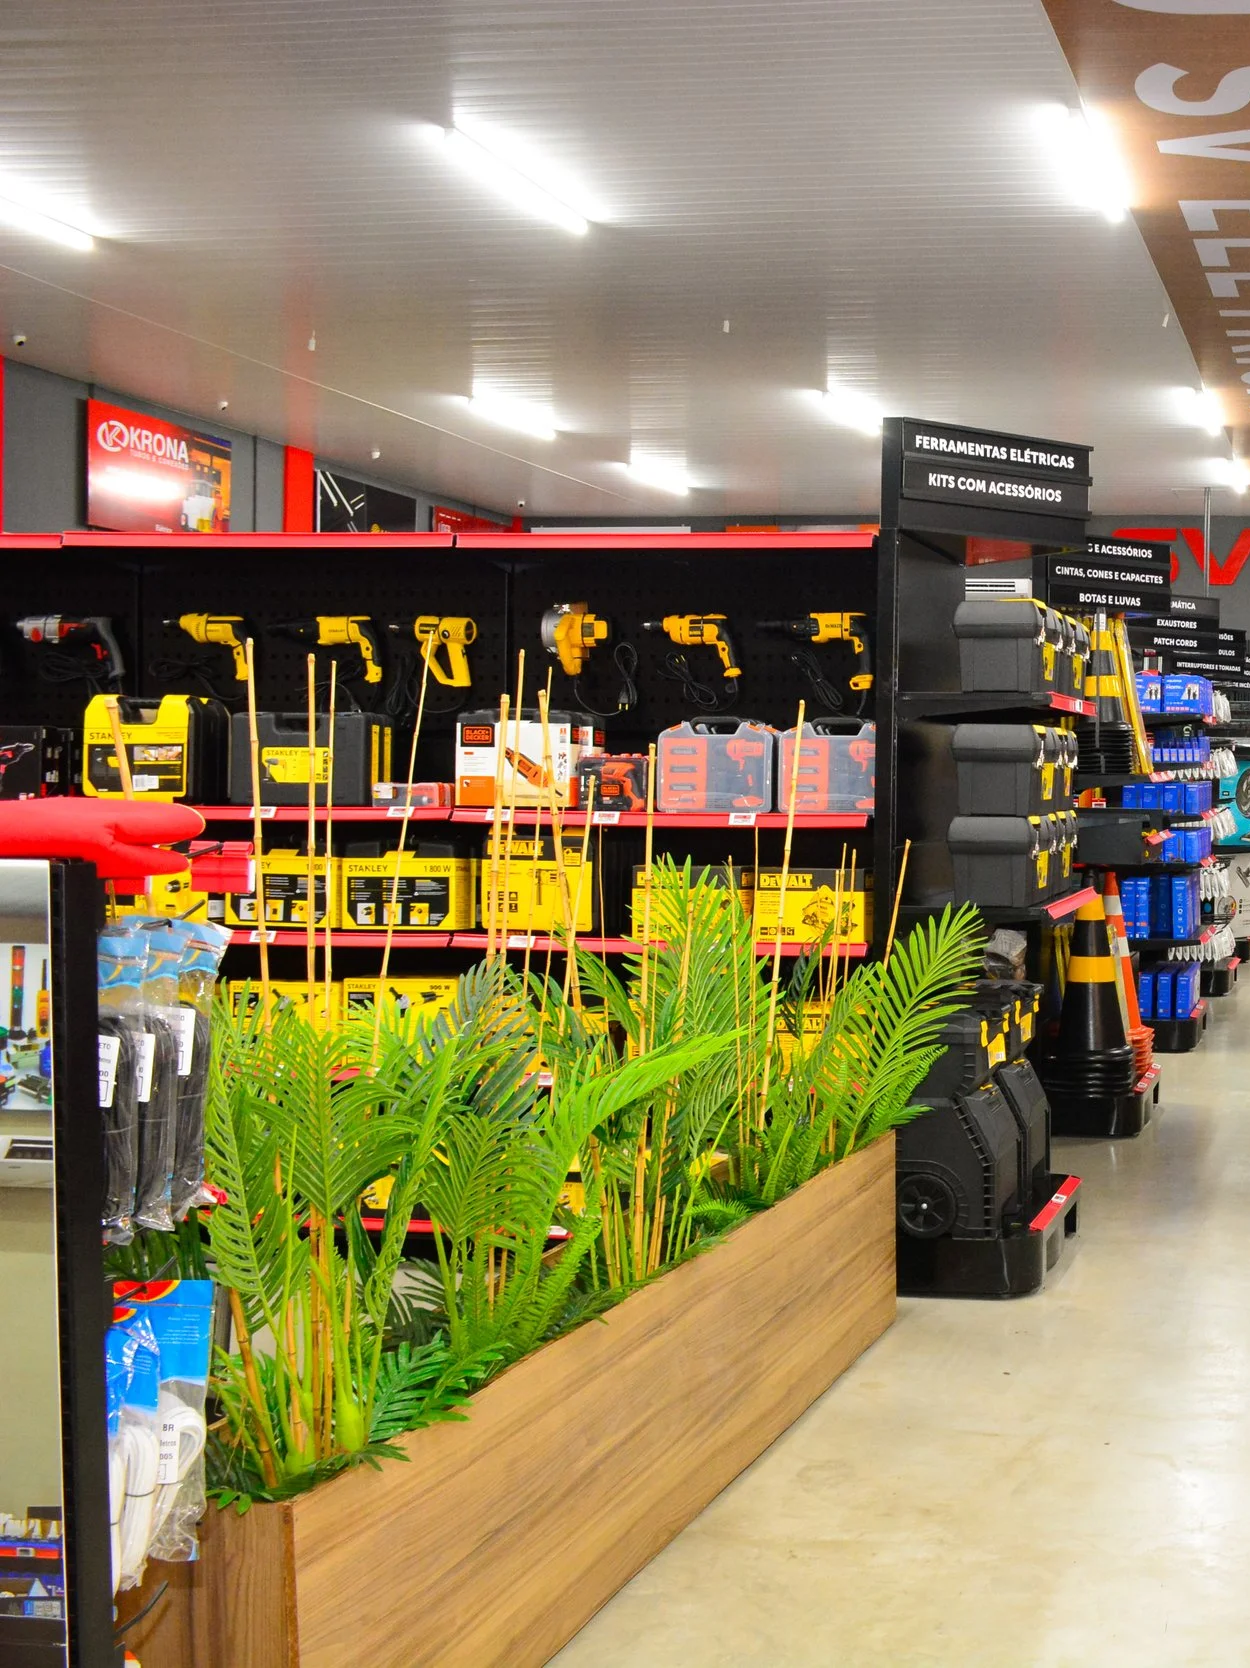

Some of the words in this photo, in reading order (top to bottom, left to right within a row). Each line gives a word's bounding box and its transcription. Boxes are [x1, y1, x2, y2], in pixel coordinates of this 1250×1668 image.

[130, 426, 189, 463] KRONA
[915, 435, 1007, 460] FERRAMENTAS
[1010, 449, 1075, 469] ELÉTRICAS
[928, 473, 955, 488] KITS
[957, 477, 986, 493] COM
[988, 479, 1062, 502] ACESSÓRIOS
[1094, 544, 1100, 554] E
[1101, 543, 1152, 559] ACESSÓRIOS
[1055, 565, 1085, 578] CINTAS,
[1086, 568, 1113, 580] CONES
[1114, 571, 1119, 580] E
[1120, 571, 1163, 584] CAPACETES
[1079, 593, 1107, 605] BOTAS
[1108, 595, 1114, 605] E
[1114, 595, 1141, 607] LUVAS
[1156, 619, 1197, 629] EXAUSTORES
[1153, 637, 1175, 647] PATCH
[1176, 638, 1198, 648] CORDS
[1176, 661, 1215, 670] INTERRUPTORES
[1218, 664, 1241, 672] TOMADAS
[89, 732, 132, 740] STANEY
[266, 749, 299, 757] STANLEY
[488, 840, 544, 856] EWALT
[348, 864, 388, 873] STANLEY
